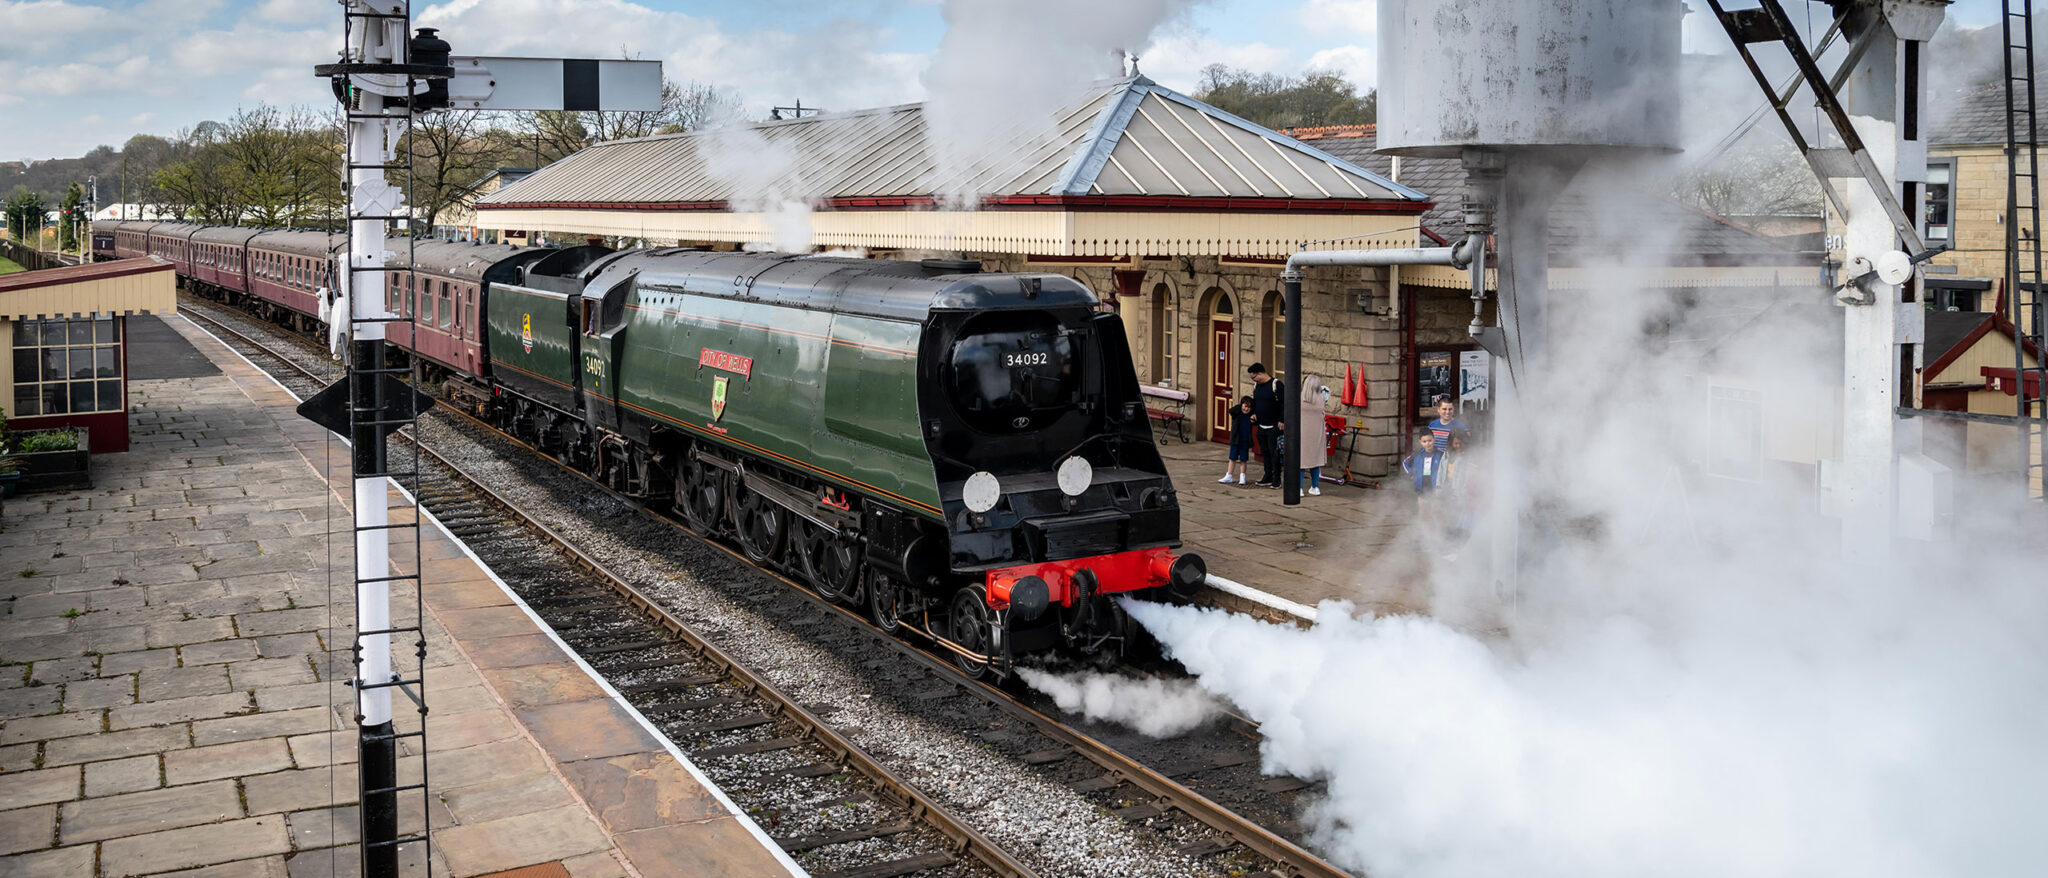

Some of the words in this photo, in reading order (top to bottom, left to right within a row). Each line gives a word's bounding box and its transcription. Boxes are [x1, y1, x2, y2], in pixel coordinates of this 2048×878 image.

[586, 356, 606, 378] 34092
[703, 350, 717, 365] CITY
[718, 353, 728, 369] OF
[728, 356, 749, 373] WELLS
[1007, 352, 1047, 366] 34092
